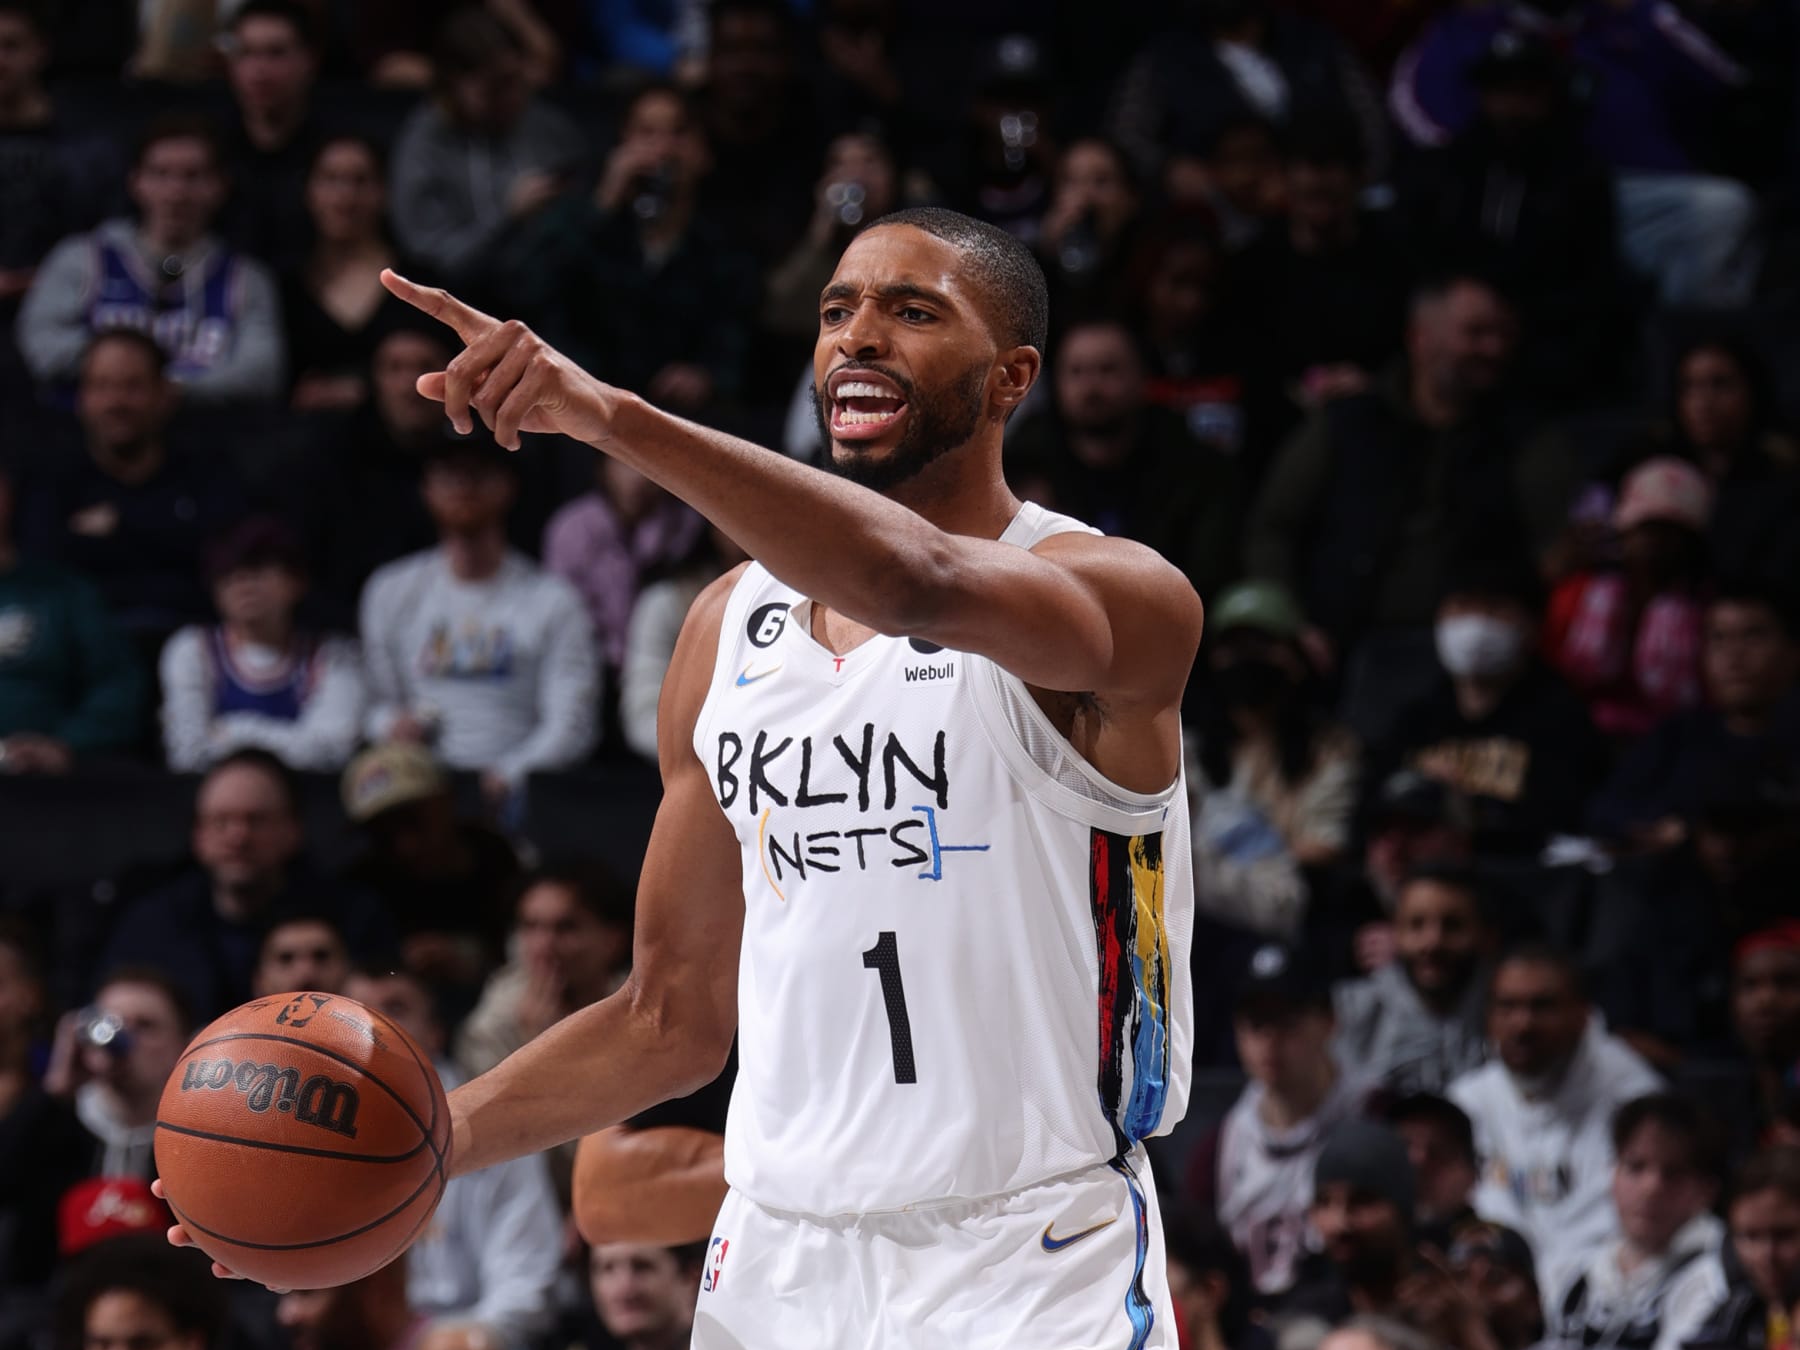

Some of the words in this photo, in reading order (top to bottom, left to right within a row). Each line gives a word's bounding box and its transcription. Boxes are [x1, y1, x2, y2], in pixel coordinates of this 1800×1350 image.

[754, 607, 789, 645] 6
[904, 662, 955, 682] Webull
[718, 723, 949, 816] BKLYN
[862, 931, 918, 1085] 1
[179, 1057, 362, 1140] Wilson
